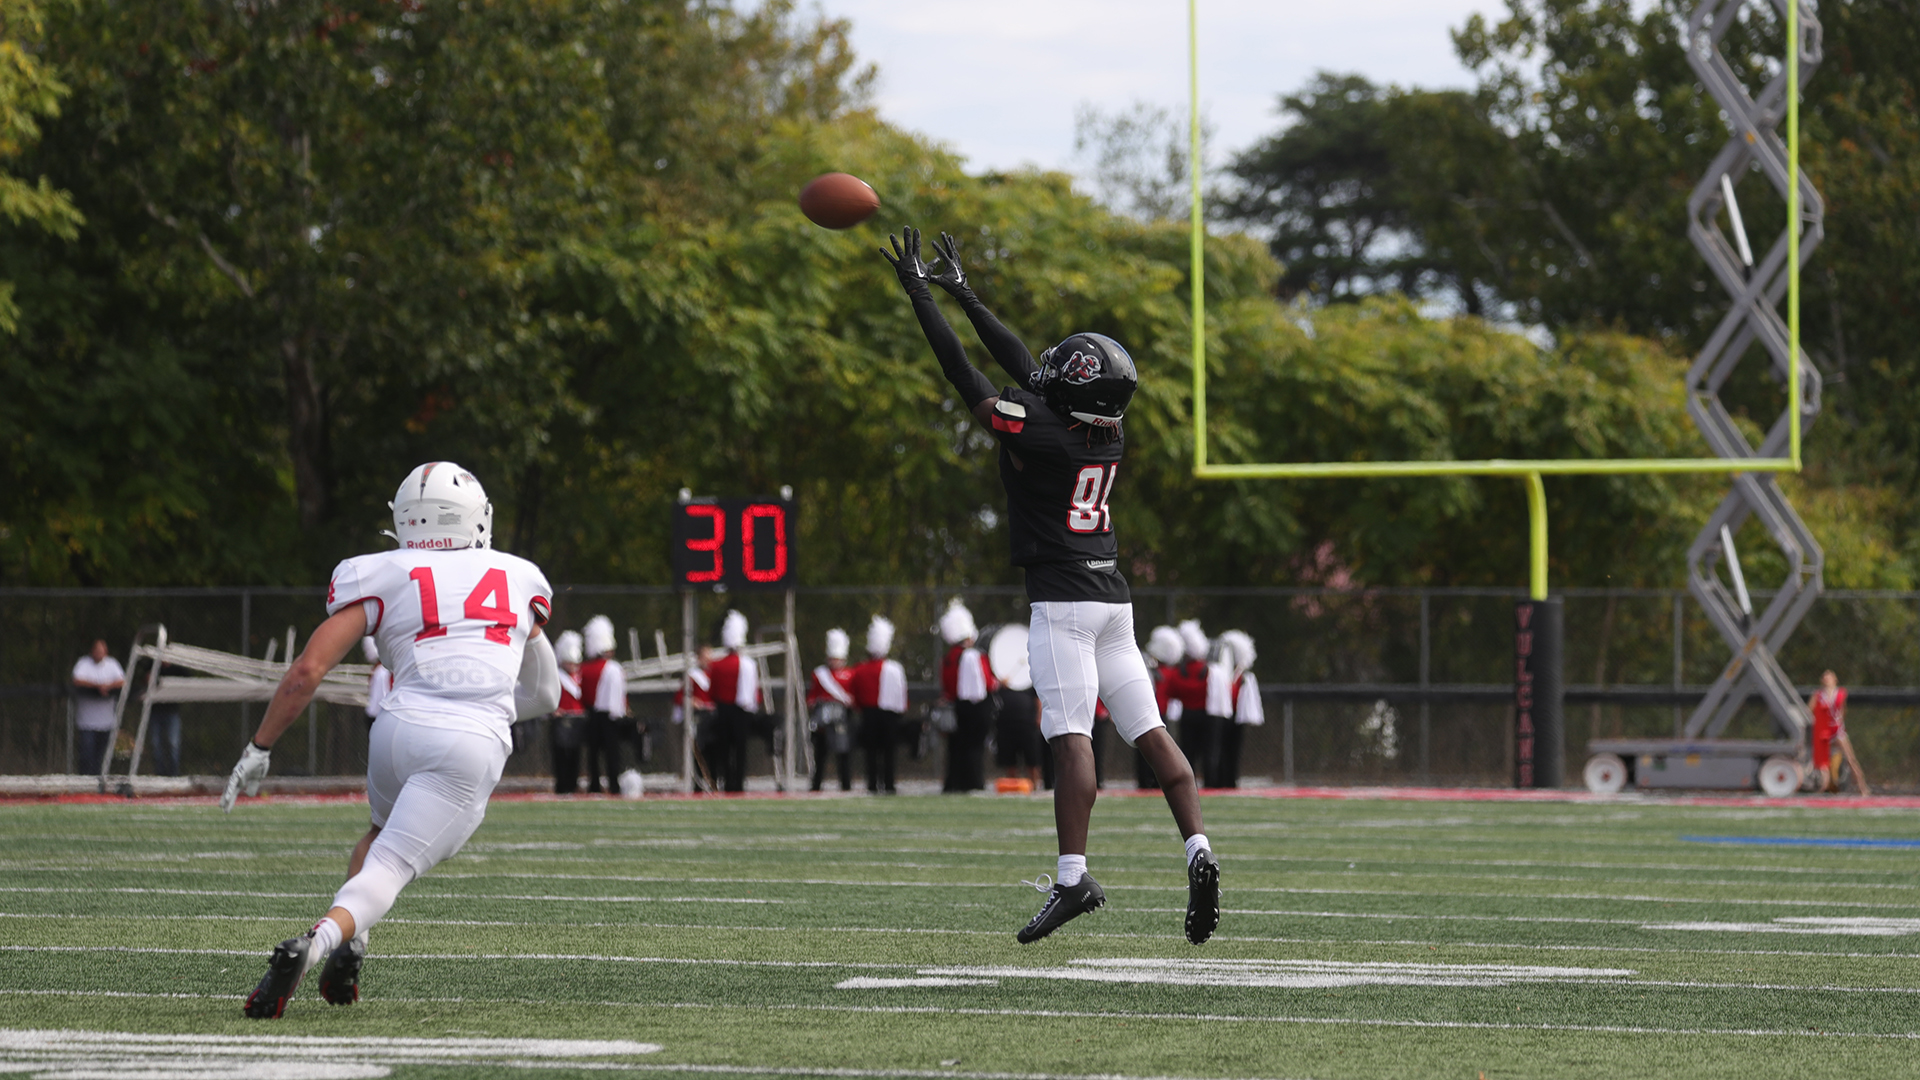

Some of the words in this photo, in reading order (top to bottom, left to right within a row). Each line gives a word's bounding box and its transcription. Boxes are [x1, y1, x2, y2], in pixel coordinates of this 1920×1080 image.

[406, 538, 453, 550] Riddell
[685, 504, 787, 582] 30
[409, 566, 518, 646] 14
